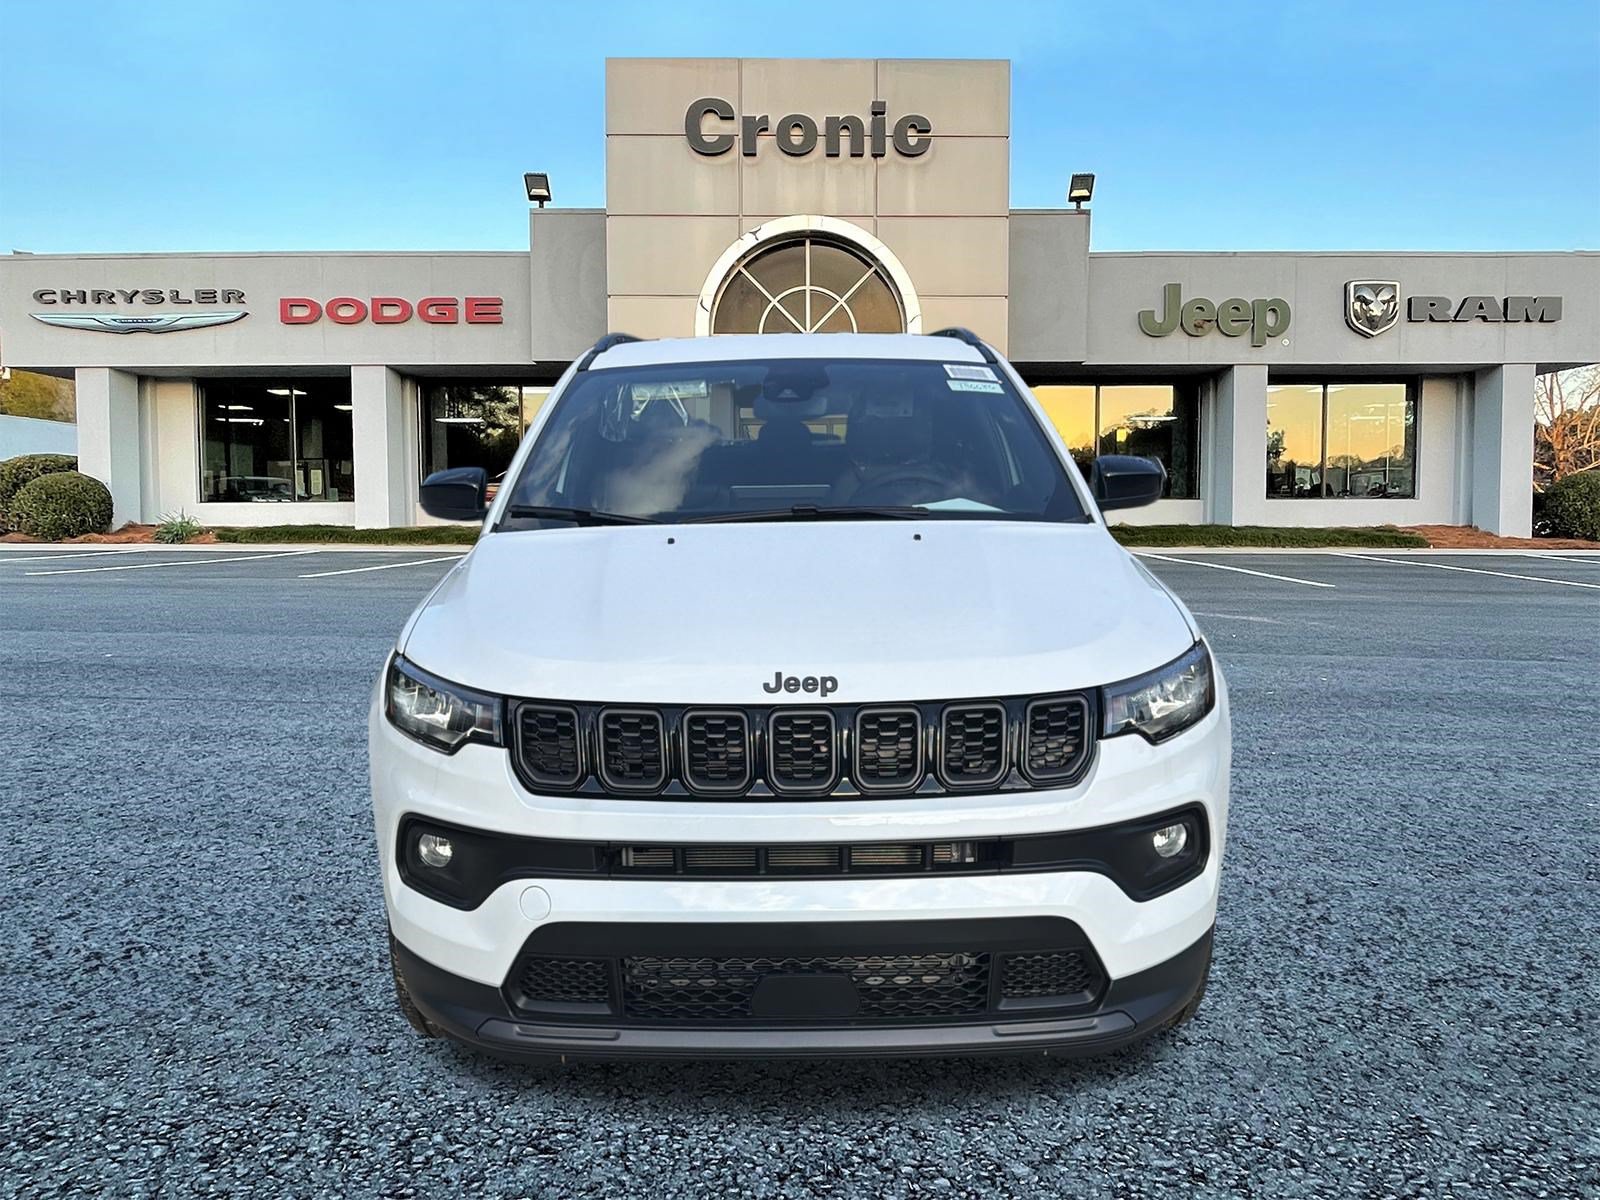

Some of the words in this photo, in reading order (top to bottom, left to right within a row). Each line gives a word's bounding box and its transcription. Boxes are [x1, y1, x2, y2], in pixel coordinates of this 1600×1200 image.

[685, 97, 932, 157] Cronic
[32, 289, 246, 304] CHRYSLER
[1407, 296, 1563, 322] RAM
[279, 297, 503, 324] DODGE
[1138, 283, 1291, 347] Jeep
[762, 671, 838, 697] Jeep
